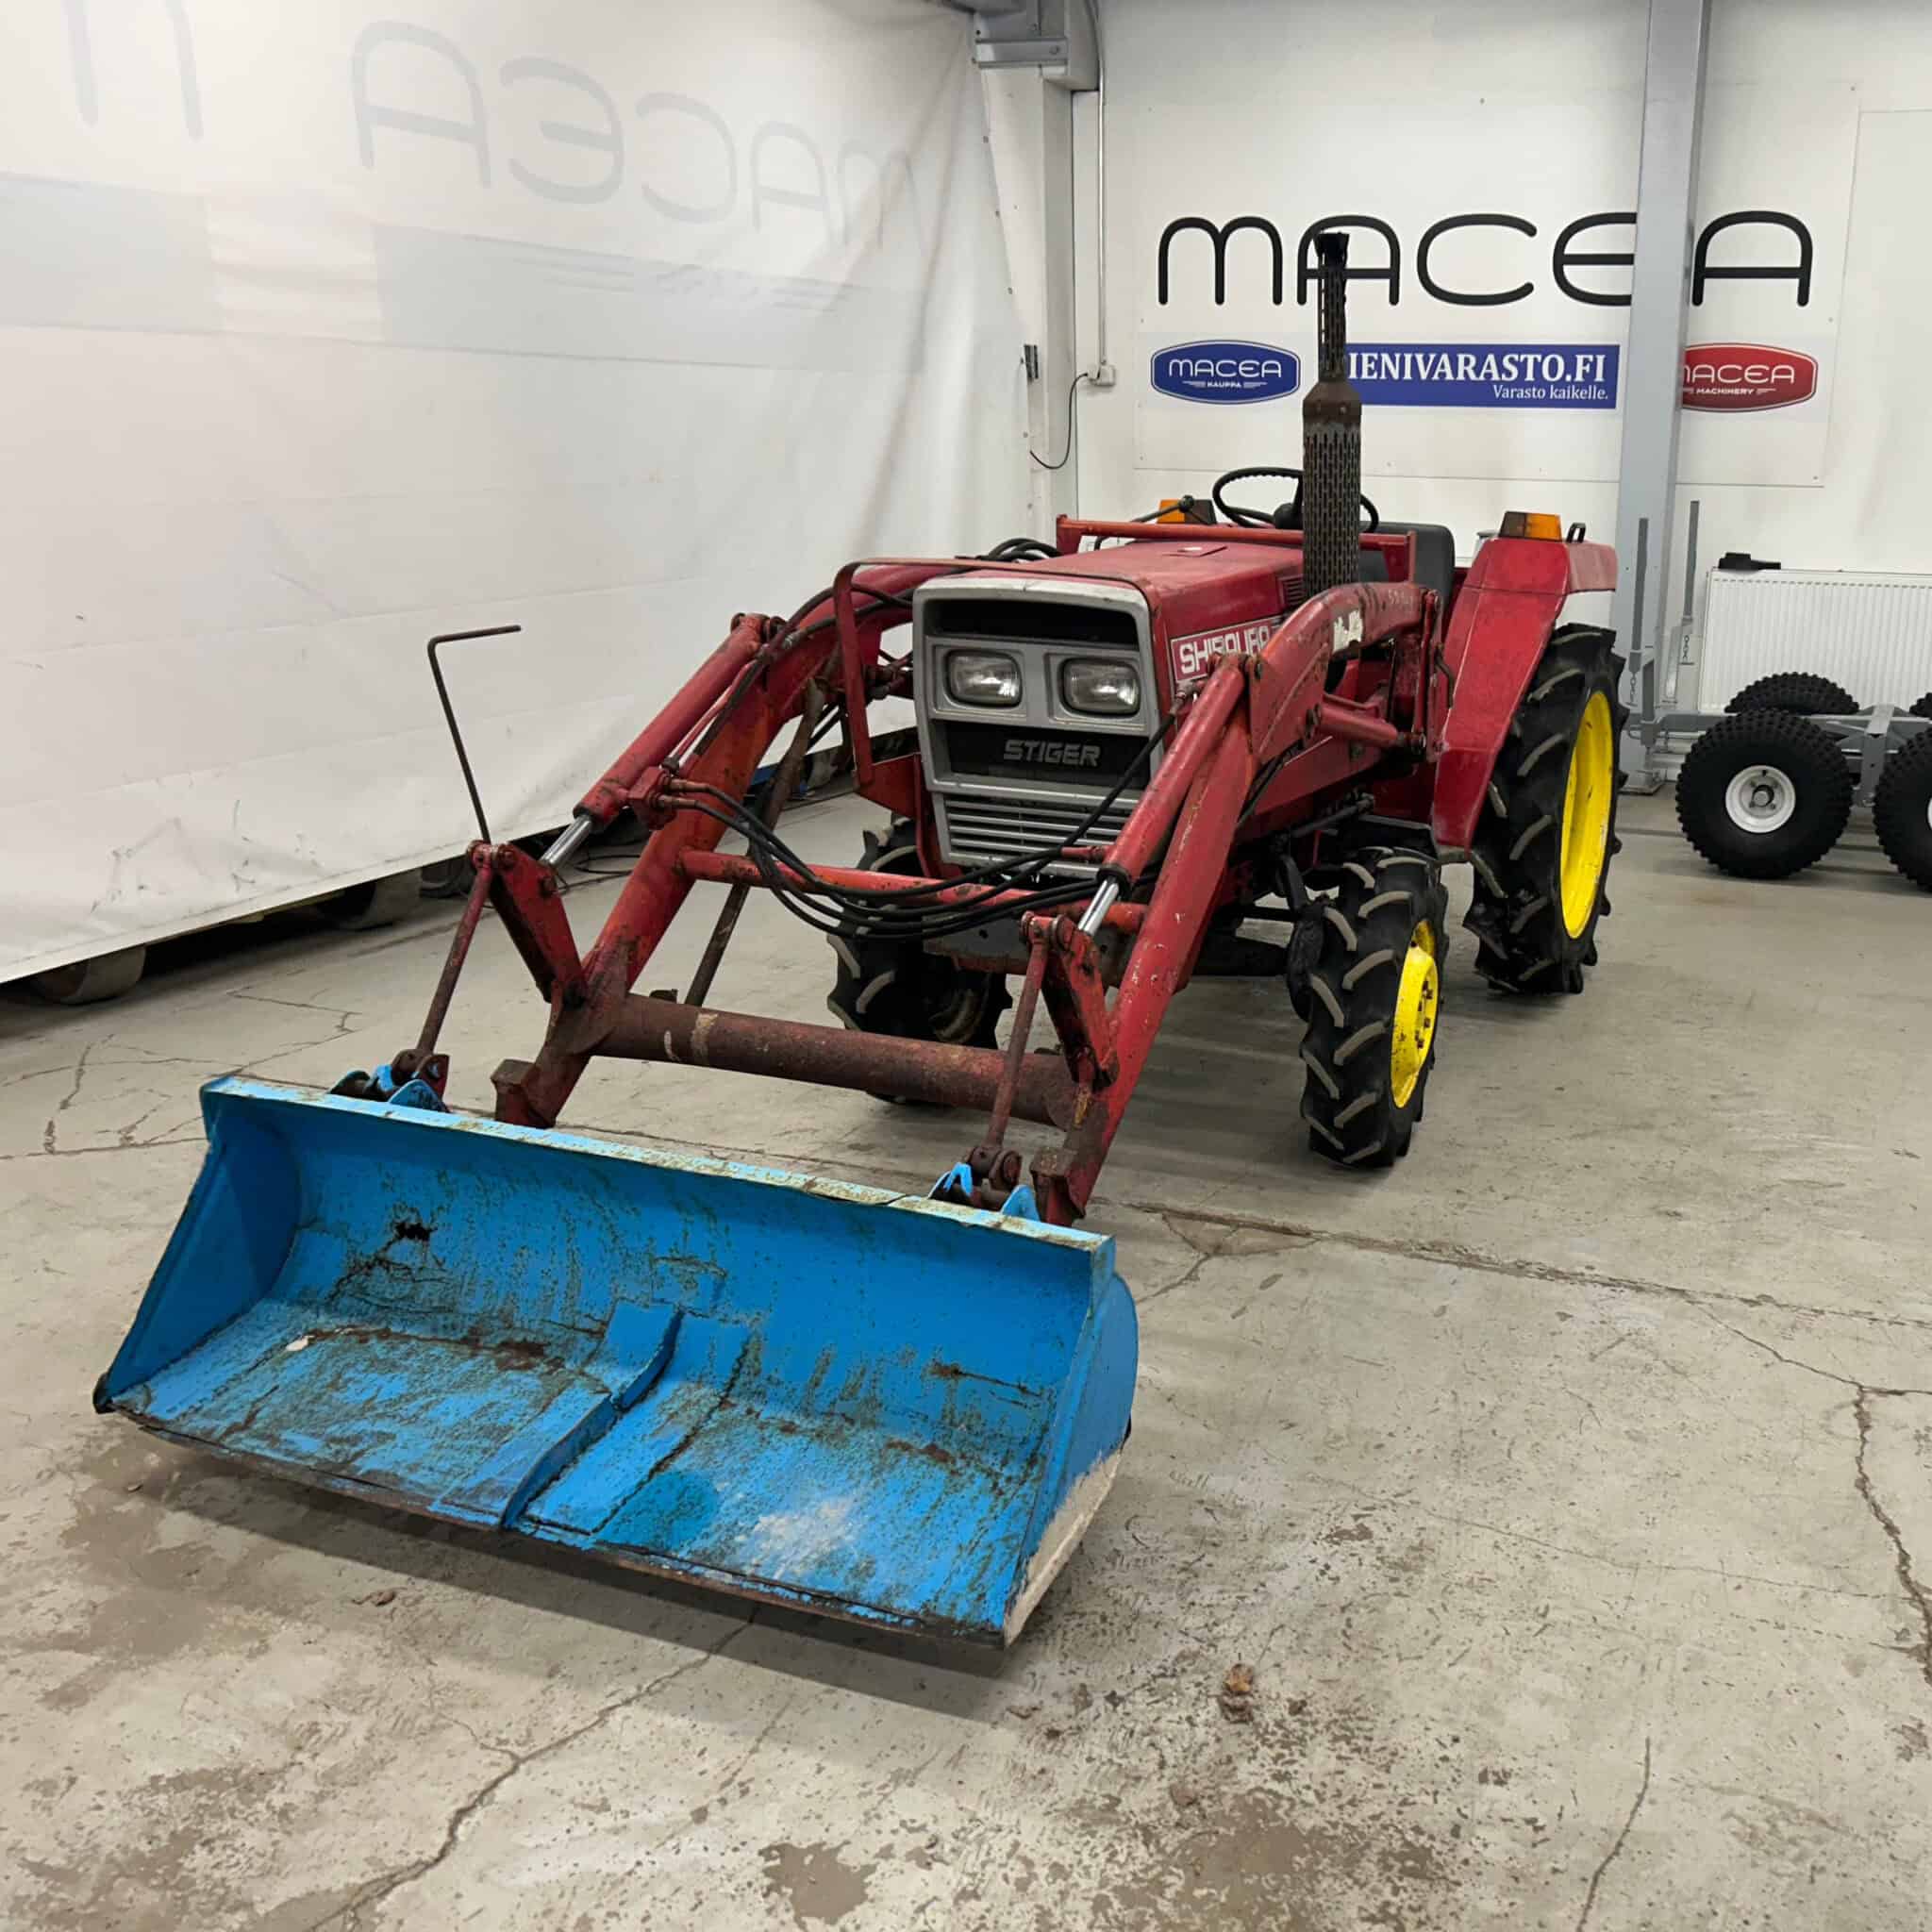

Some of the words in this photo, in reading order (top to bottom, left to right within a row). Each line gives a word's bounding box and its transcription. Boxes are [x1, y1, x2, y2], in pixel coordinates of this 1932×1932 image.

[1169, 359, 1282, 378] MACEA
[1348, 352, 1606, 382] IENIVARASTO.FI
[1207, 381, 1242, 390] KAUPPA
[1493, 384, 1546, 400] Varasto
[1550, 384, 1608, 401] kaikelle.
[1003, 739, 1101, 767] STIGER
